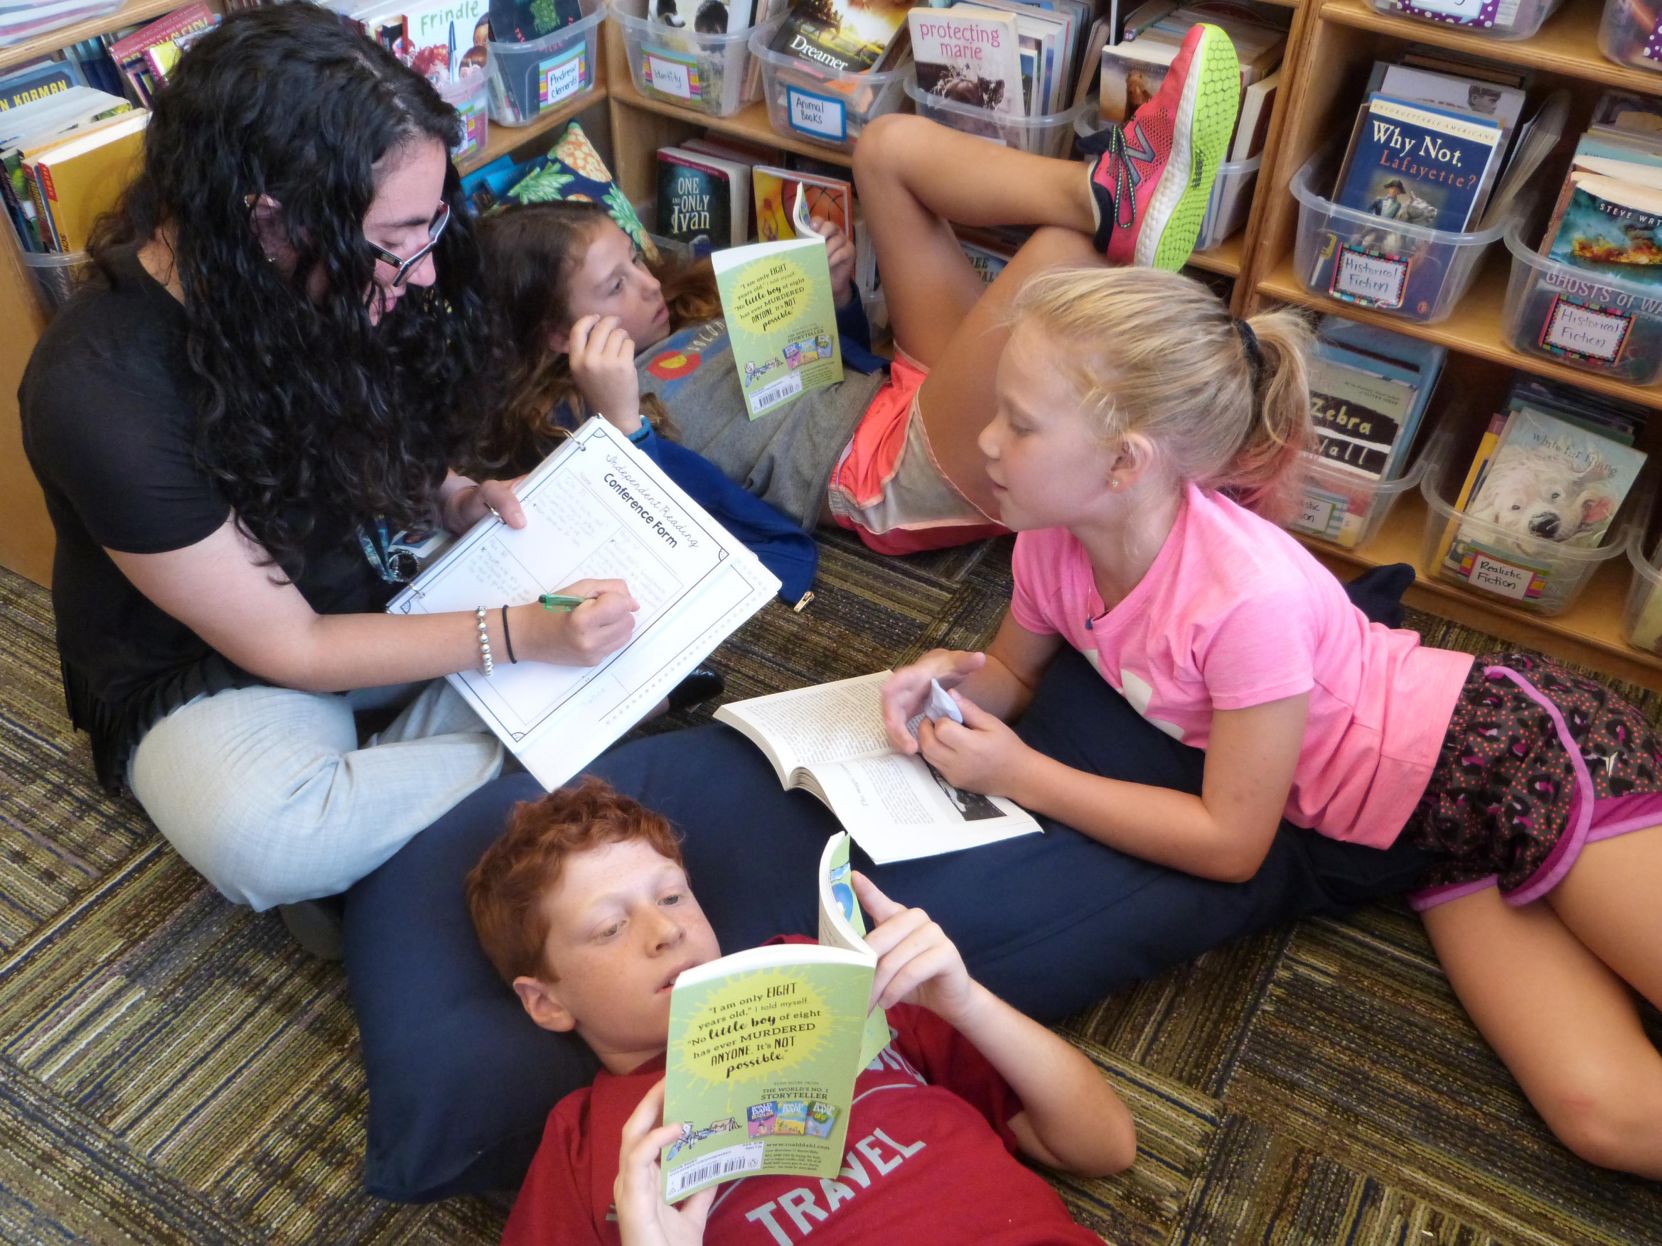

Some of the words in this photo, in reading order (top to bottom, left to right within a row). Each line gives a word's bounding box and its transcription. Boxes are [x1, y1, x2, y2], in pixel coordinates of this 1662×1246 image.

[421, 1, 479, 36] Frindle
[920, 22, 1001, 48] protecting
[790, 34, 849, 71] Dreamer
[941, 42, 983, 60] marie
[13, 80, 68, 107] KORMAN
[796, 97, 825, 113] Animal
[1373, 120, 1416, 157] Why
[1380, 149, 1477, 190] Lafayette?
[678, 177, 700, 195] ONE
[681, 194, 710, 213] ONLY
[1599, 202, 1632, 219] STEVE
[672, 205, 710, 234] Ivan
[1545, 270, 1613, 303] GHOSTS
[1560, 308, 1620, 332] Historical
[1310, 396, 1373, 435] Zebra
[1318, 438, 1369, 465] all
[604, 473, 655, 525] Conference
[652, 520, 678, 549] Form
[1477, 572, 1517, 590] Fiction
[1480, 560, 1523, 580] Realistic
[719, 1002, 737, 1012] am
[739, 993, 764, 1005] only
[766, 982, 798, 999] EIGHT
[697, 1016, 727, 1031] years
[760, 1001, 778, 1013] told
[780, 997, 808, 1010] myself
[708, 1021, 746, 1041] little
[751, 1013, 777, 1029] boy
[779, 1012, 793, 1021] of
[793, 1009, 822, 1021] eight
[693, 1047, 712, 1060] has
[713, 1040, 737, 1052] ever
[740, 1022, 817, 1044] MURDERED
[774, 1035, 796, 1049] NOT
[760, 1092, 829, 1101] STORYTELLER
[744, 1127, 928, 1246] TRAVEL
